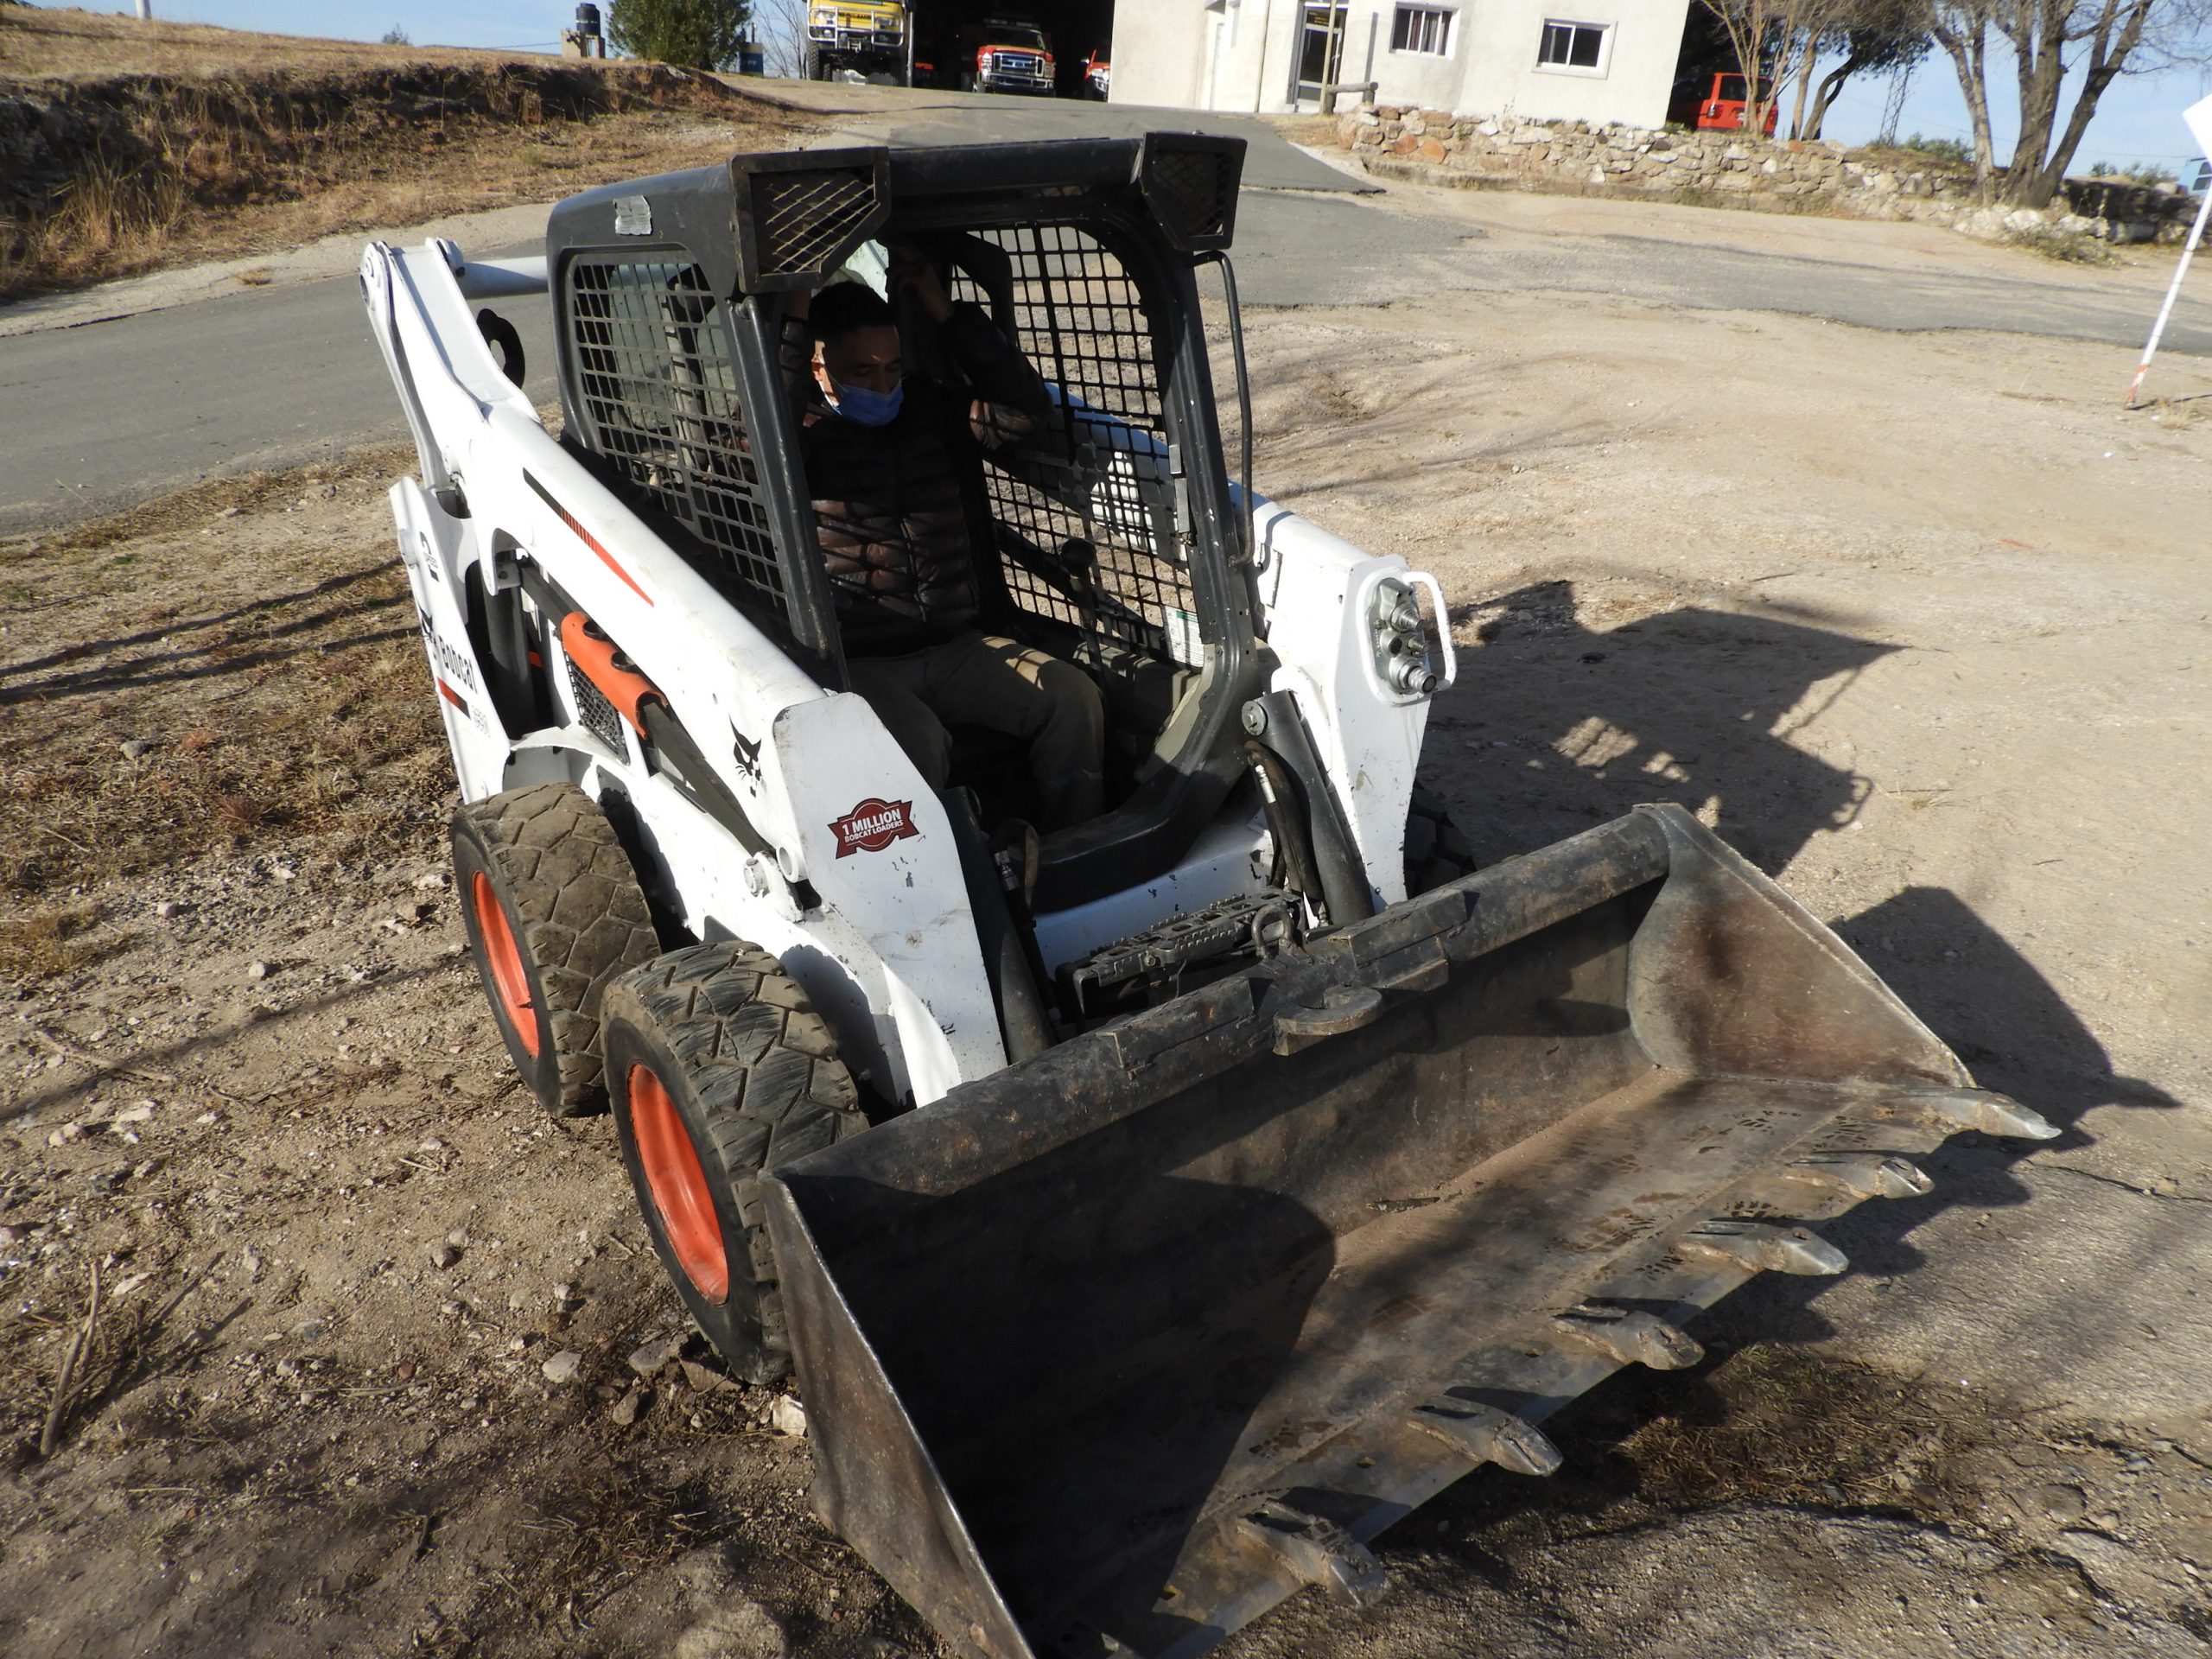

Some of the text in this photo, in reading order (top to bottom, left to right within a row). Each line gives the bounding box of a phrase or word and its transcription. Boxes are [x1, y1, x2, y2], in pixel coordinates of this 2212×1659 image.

[438, 635, 478, 695] Bobcat
[842, 809, 901, 836] 1 MILLION
[844, 819, 904, 843] BOBCAT LOADERS
